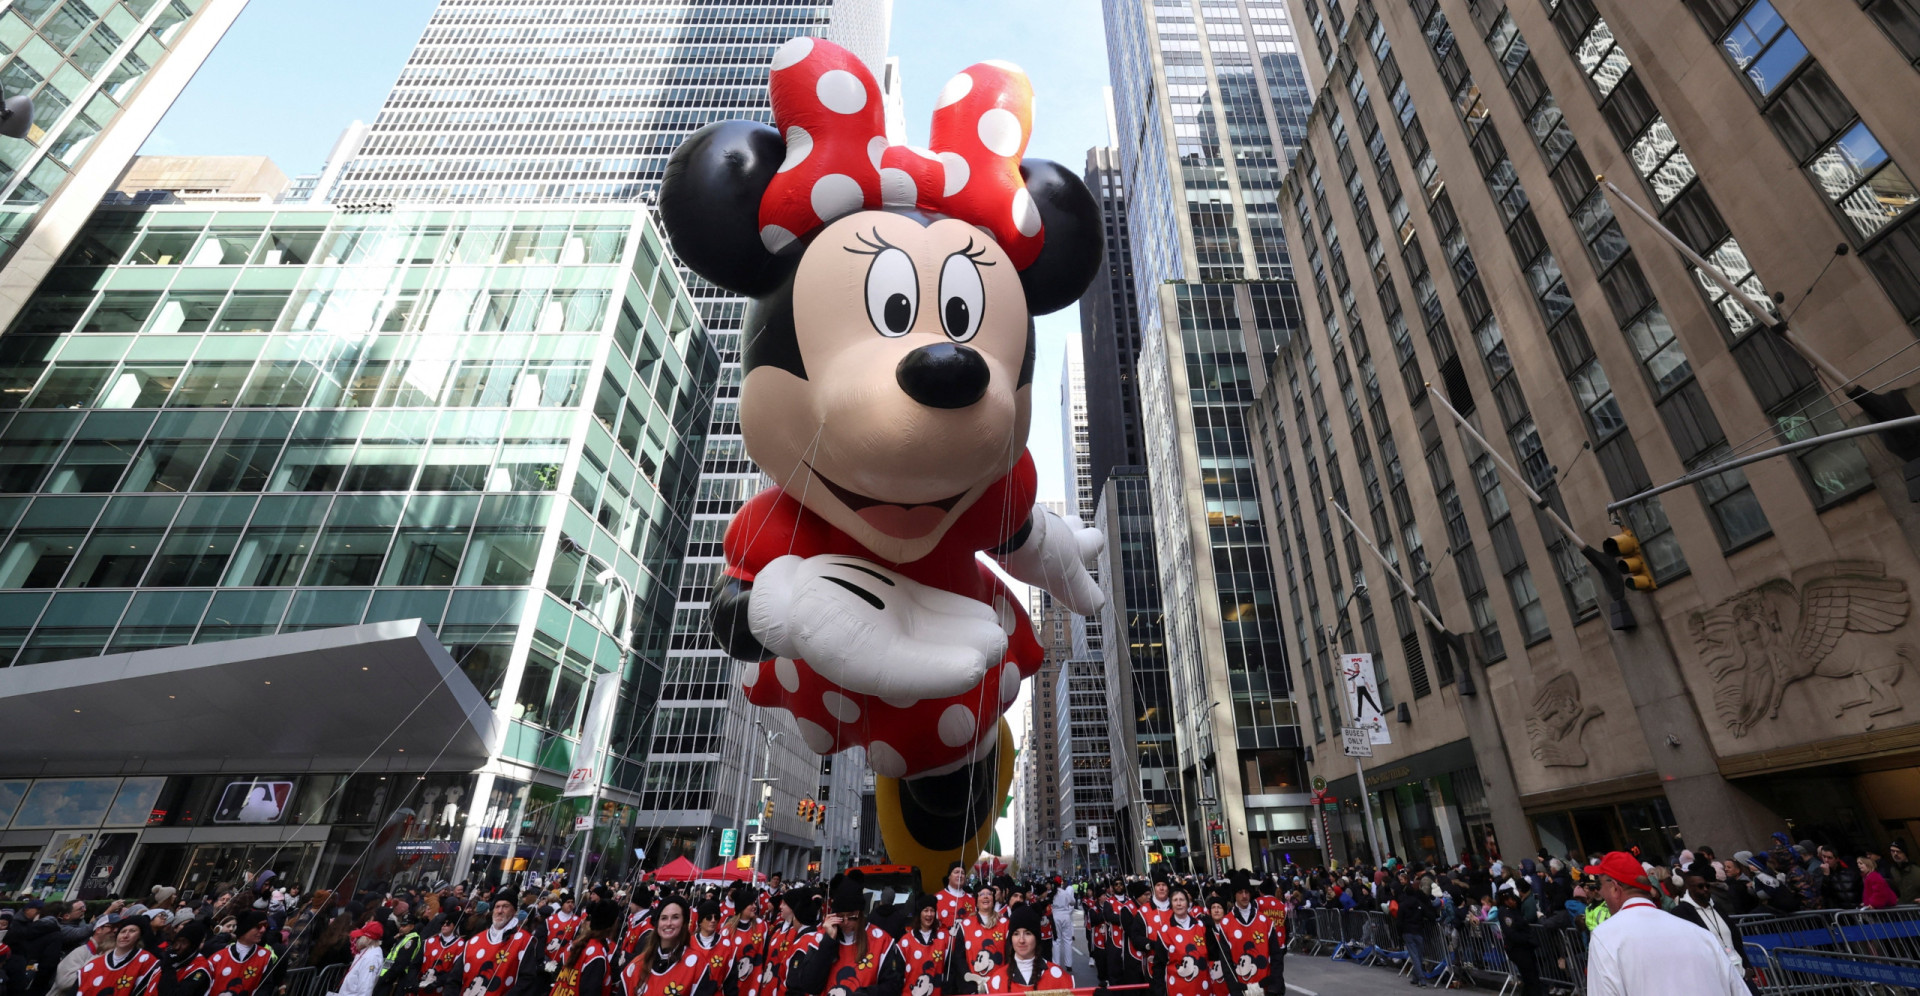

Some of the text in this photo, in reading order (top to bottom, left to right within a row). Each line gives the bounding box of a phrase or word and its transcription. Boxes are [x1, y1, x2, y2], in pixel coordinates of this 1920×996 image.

[1345, 729, 1364, 737] BUSES
[571, 768, 593, 780] 1271
[1277, 836, 1309, 844] CHASE
[84, 879, 108, 888] NYC
[1263, 909, 1285, 918] MINNIE
